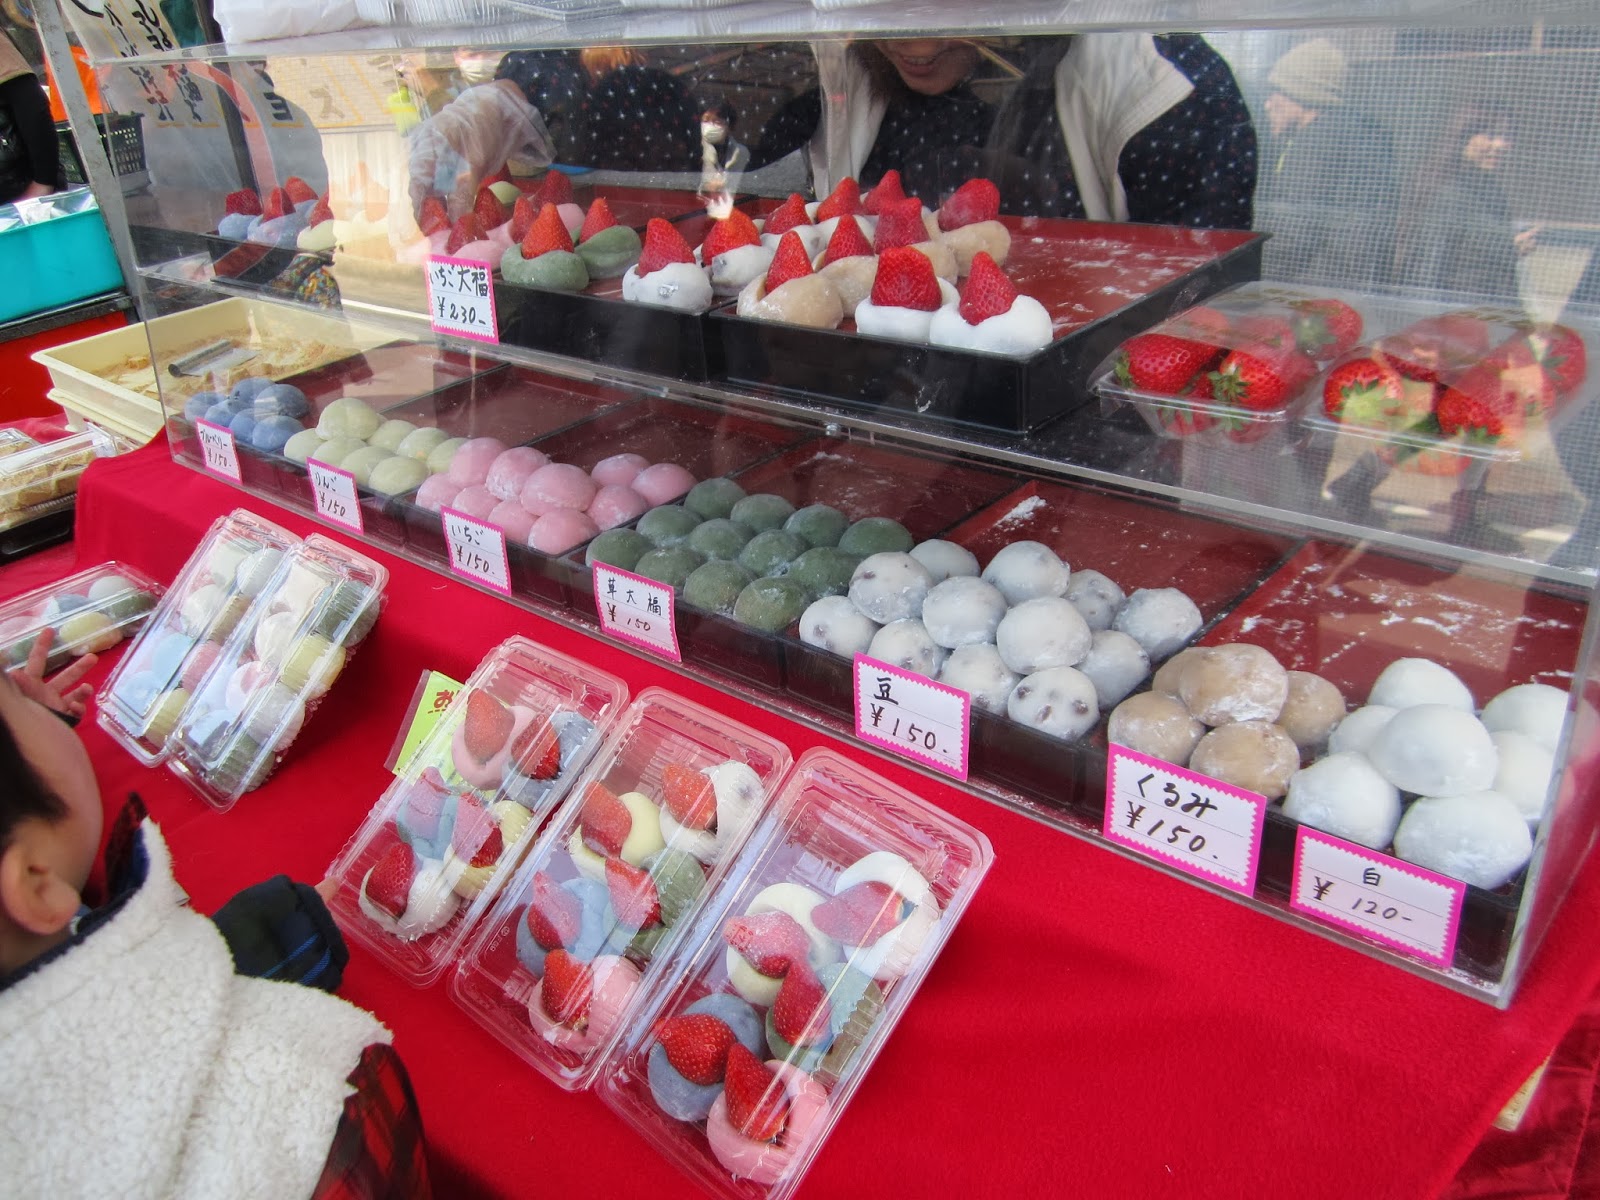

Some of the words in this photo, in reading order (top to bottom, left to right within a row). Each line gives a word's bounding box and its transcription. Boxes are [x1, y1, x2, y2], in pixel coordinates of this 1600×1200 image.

[429, 264, 488, 297] いちご大福
[315, 471, 337, 492] りんご
[319, 490, 346, 516] ¥150
[451, 524, 484, 546] いちご
[606, 577, 662, 616] 草大福
[873, 677, 899, 706] 豆
[1137, 773, 1218, 818] くるみ
[1363, 867, 1381, 887] 白
